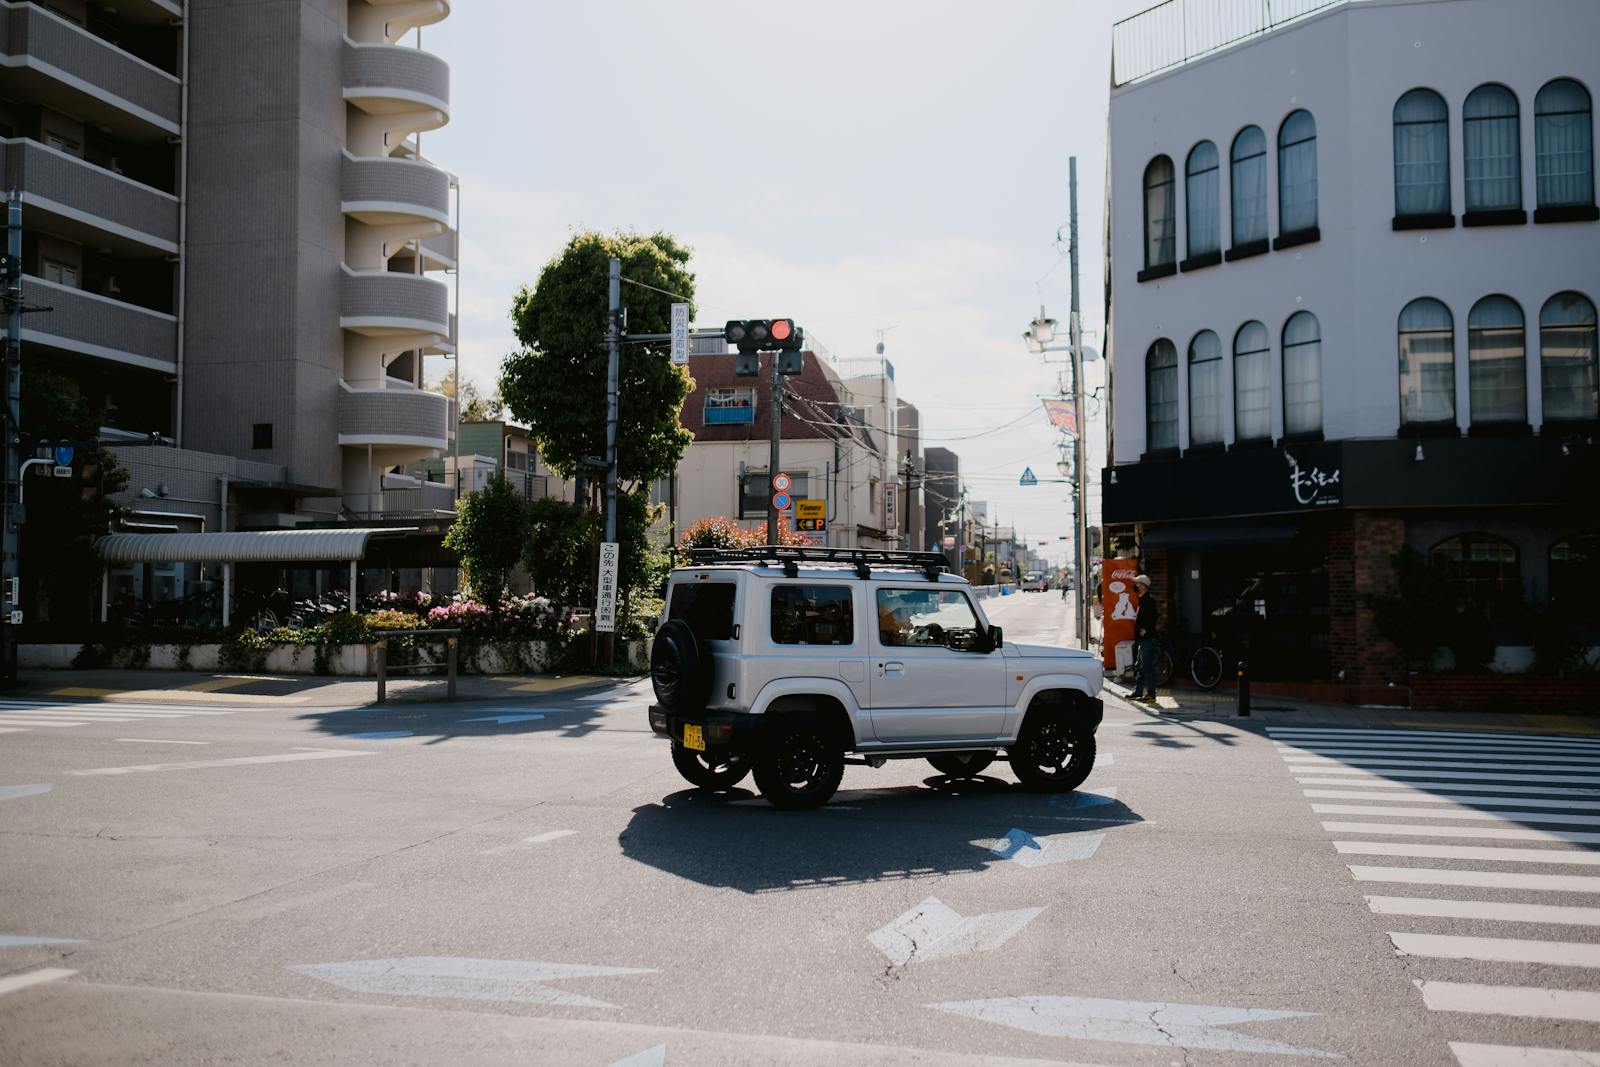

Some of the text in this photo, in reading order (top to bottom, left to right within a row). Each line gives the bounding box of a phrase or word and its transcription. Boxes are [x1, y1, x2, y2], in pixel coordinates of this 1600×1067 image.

[675, 307, 685, 360] 防災対応型
[1284, 450, 1340, 504] もっくもっく
[816, 519, 824, 530] P
[603, 544, 615, 567] この先
[601, 569, 613, 621] 大型車通行困難
